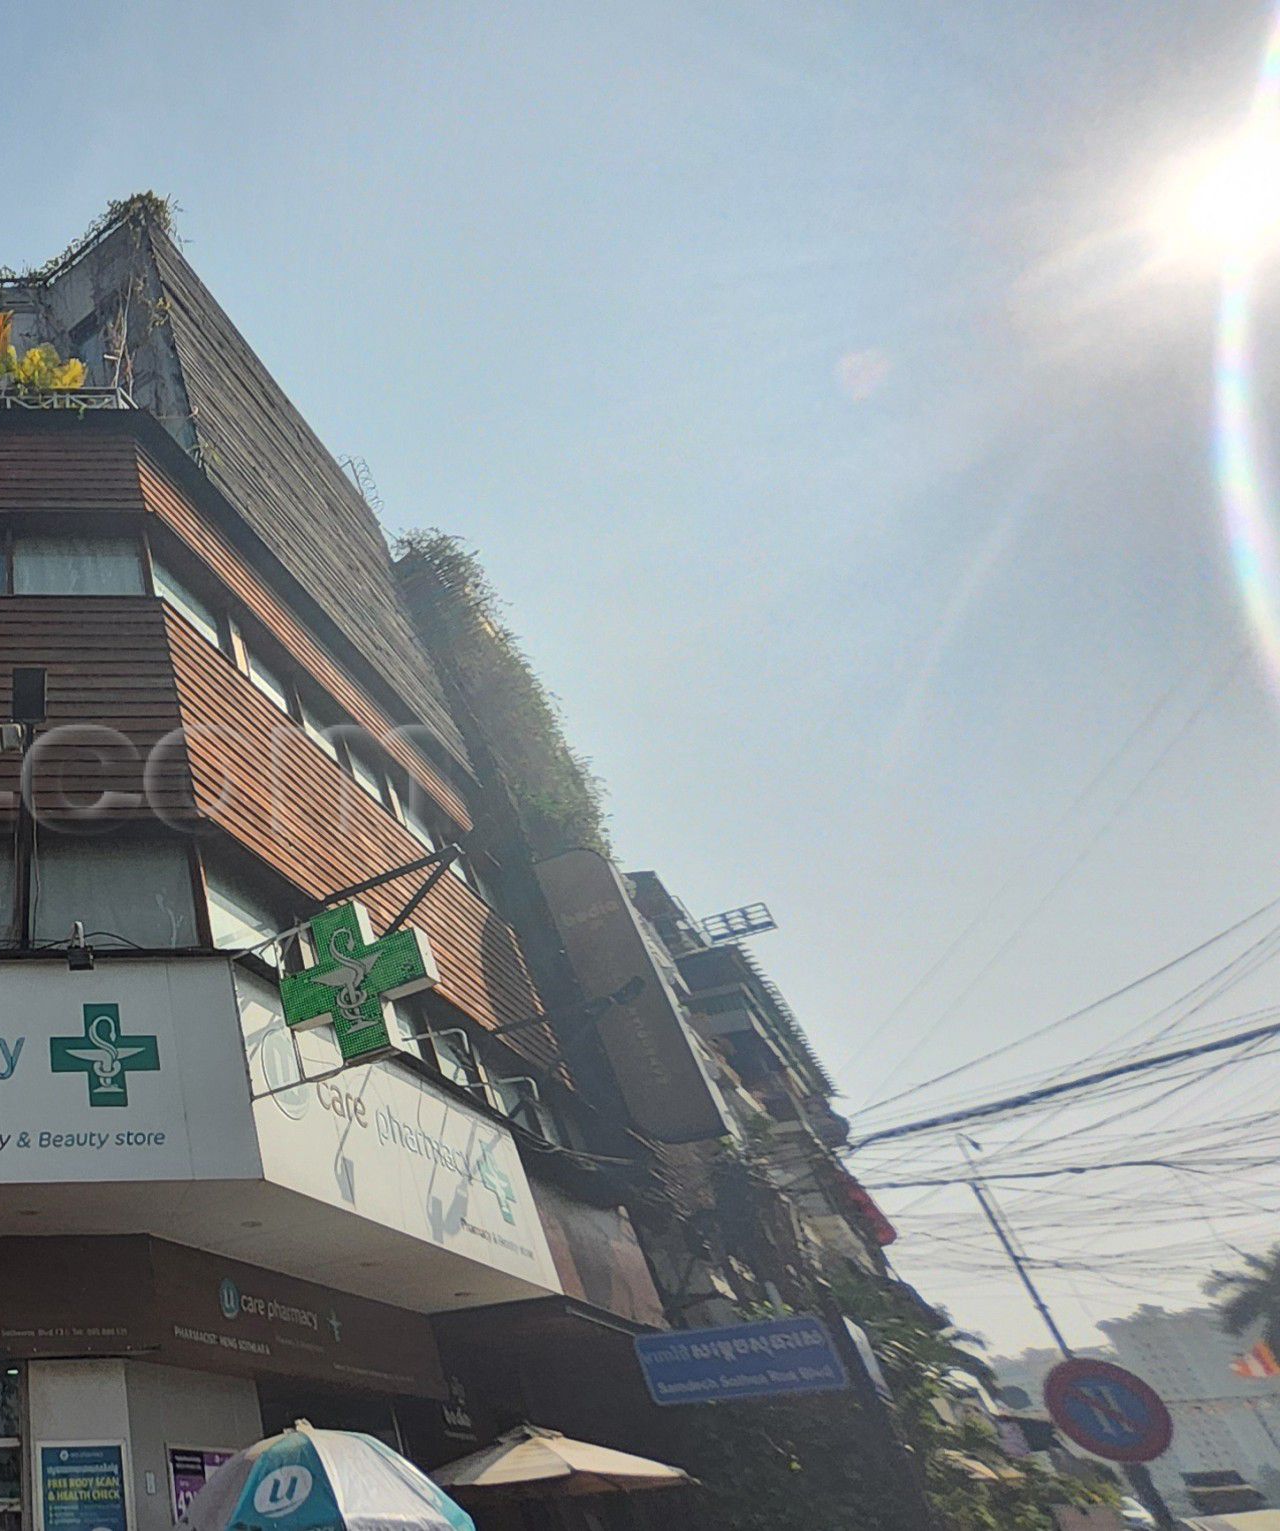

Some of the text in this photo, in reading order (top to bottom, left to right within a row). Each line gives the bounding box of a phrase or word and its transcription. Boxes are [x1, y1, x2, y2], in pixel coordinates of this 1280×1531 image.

[15, 1131, 32, 1149] &
[37, 1130, 111, 1150] Beauty
[114, 1130, 167, 1147] store
[316, 1080, 369, 1130] care
[374, 1103, 474, 1187] pharmacy
[240, 1294, 266, 1316] care
[266, 1300, 319, 1331] pharmacy
[47, 1478, 68, 1489] FREE
[95, 1476, 120, 1488] SCAN
[56, 1489, 91, 1501] HEALTH
[91, 1489, 121, 1501] CHECK
